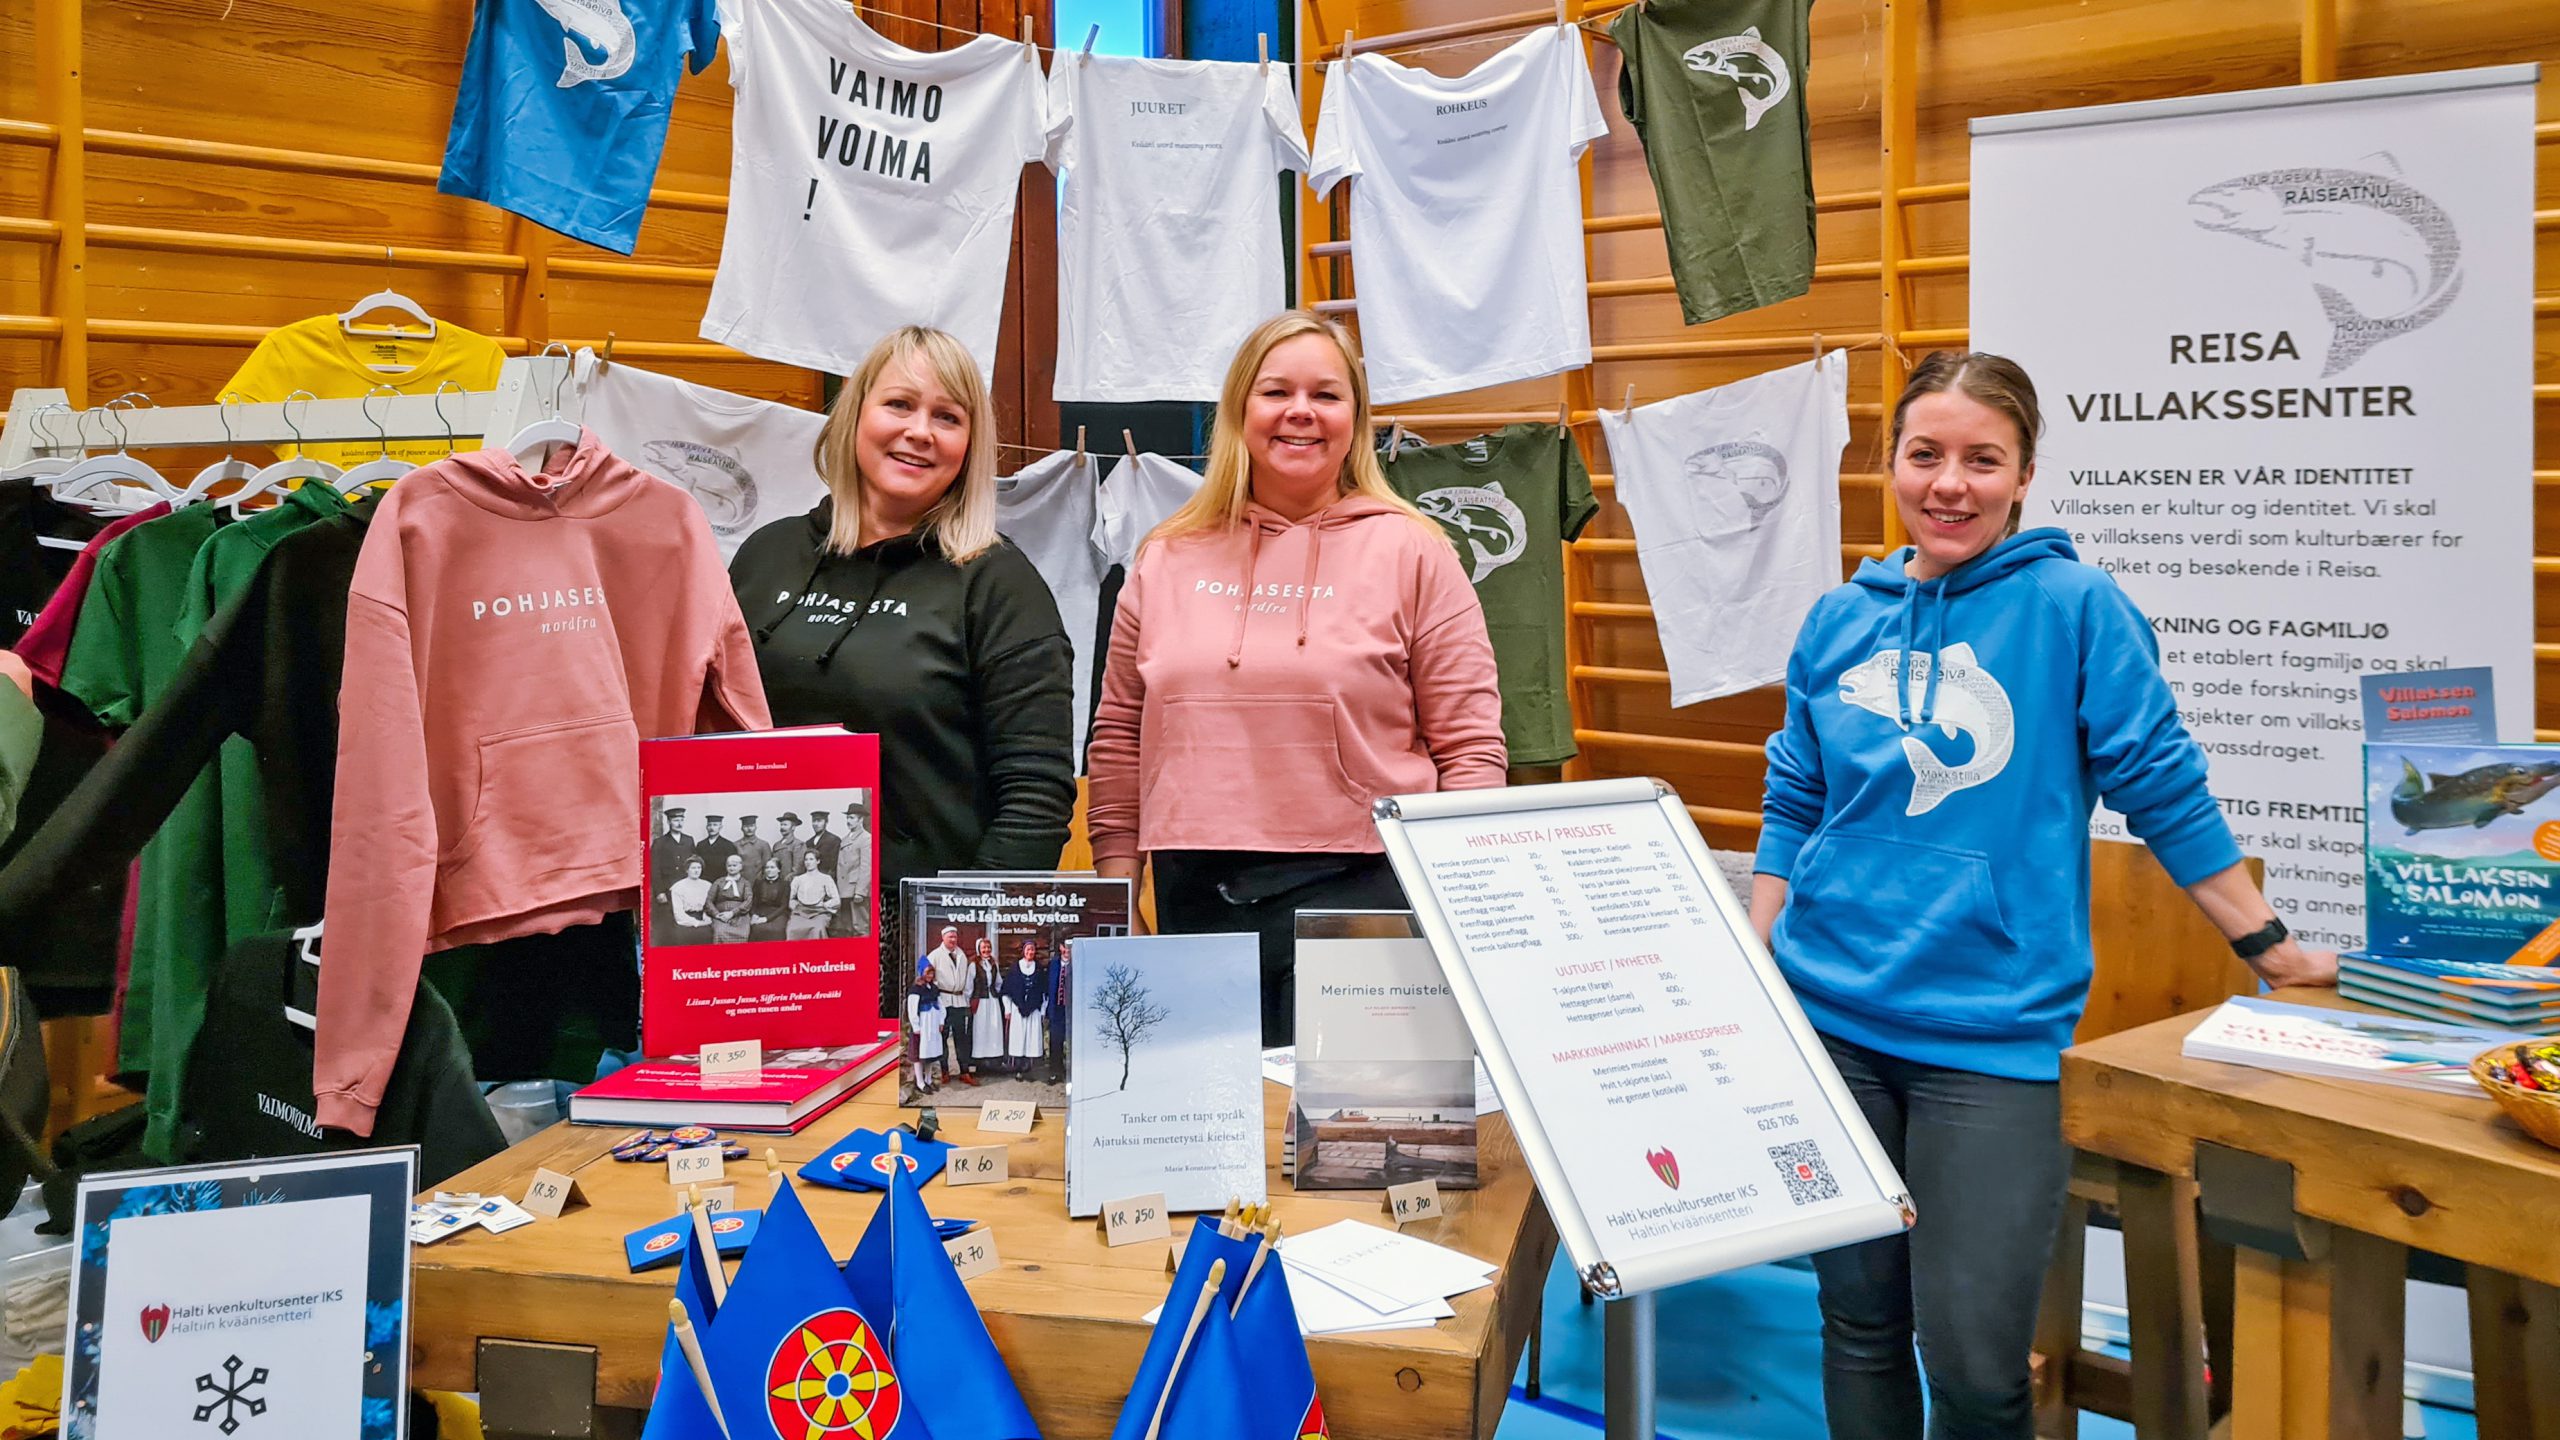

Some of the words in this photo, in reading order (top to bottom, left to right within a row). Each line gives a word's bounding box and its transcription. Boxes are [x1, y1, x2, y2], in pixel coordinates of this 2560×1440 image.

[830, 56, 943, 123] VAIMO
[1130, 101, 1186, 117] JUURET
[1436, 98, 1488, 116] ROHKEUS
[818, 115, 931, 183] VOIMA
[803, 178, 819, 221] !
[2170, 330, 2301, 365] REISA
[2067, 385, 2417, 423] VILLAKSSENTER
[2070, 470, 2192, 486] VILLAKSEN
[2199, 470, 2225, 486] ER
[2234, 465, 2286, 486] VÅR
[2295, 468, 2413, 485] IDENTITET
[2051, 499, 2135, 515] Villaksen
[2142, 504, 2161, 515] er
[2168, 499, 2224, 515] kultur
[2231, 504, 2256, 519] og
[2264, 498, 2355, 516] identitet.
[2364, 499, 2386, 515] Vi
[2393, 499, 2436, 516] skal
[2092, 529, 2184, 545] villaksens
[2191, 529, 2242, 546] verdi
[2249, 534, 2288, 546] som
[2295, 529, 2421, 548] kulturbærer
[2432, 530, 2464, 549] for
[2098, 557, 2151, 575] folket
[2158, 562, 2182, 578] og
[2189, 558, 2300, 577] besøkende
[2306, 561, 2312, 577] i
[2318, 560, 2382, 579] Reisa.
[1195, 579, 1334, 599] POHASESTA
[776, 590, 908, 617] PHJASSTA
[1234, 600, 1288, 614] nrdfra
[541, 616, 597, 634] nordfra
[2228, 618, 2261, 636] OG
[2268, 619, 2389, 640] FAGMILJØ
[2167, 650, 2186, 664] et
[2193, 649, 2274, 667] etablert
[2281, 651, 2363, 673] fagmiljø
[2192, 679, 2243, 698] gode
[2379, 686, 2476, 703] Villaksen
[2260, 714, 2290, 728] om
[2387, 705, 2472, 721] Salomon
[1466, 831, 1546, 849] HINTALISTA
[1554, 823, 1616, 841] PRISLISTE
[2261, 832, 2300, 851] skal
[941, 894, 1033, 907] Kvenfolkets
[1036, 894, 1067, 907] 500
[1069, 892, 1086, 907] år
[2273, 896, 2298, 913] og
[948, 910, 977, 923] ved
[978, 910, 1080, 926] Ishavskysten
[672, 968, 721, 981] Kvenske
[723, 965, 790, 982] personnavn
[799, 961, 856, 975] Nordreisa
[1556, 960, 1607, 977] UUTUUET
[1614, 953, 1663, 970] NYHETER
[1321, 984, 1385, 996] Merimies
[1552, 984, 1587, 997] T-skjorte
[1587, 980, 1613, 993] (farge)
[725, 1007, 736, 1017] og
[737, 1006, 756, 1014] noen
[757, 1005, 779, 1013] tusen
[781, 1003, 802, 1012] andre
[1559, 995, 1607, 1010] Hettegenser
[1608, 991, 1635, 1004] (dame)
[1566, 1008, 1614, 1024] Hettegenser
[1614, 1003, 1645, 1018] (unisex)
[1552, 1036, 1651, 1064] MARKKINAHINNAT
[1659, 1023, 1743, 1047] MARKEDSPRISER
[706, 1052, 719, 1064] KR
[728, 1050, 746, 1061] 350
[1592, 1063, 1630, 1077] Merimies
[1630, 1056, 1669, 1070] muistelee
[1600, 1079, 1617, 1091] Hvit
[1617, 1074, 1650, 1089] t-skjorte
[1650, 1071, 1672, 1084] (ass.)
[1607, 1093, 1624, 1105] Hvit
[1625, 1089, 1651, 1103] genser
[257, 1092, 323, 1140] VAIMOVOIMA
[986, 1109, 1000, 1121] KR
[1003, 1108, 1026, 1122] 250
[1743, 1099, 1795, 1115] Vippsnummer
[1121, 1113, 1156, 1124] Tanker
[1160, 1114, 1177, 1122] om
[1180, 1113, 1189, 1122] et
[1193, 1112, 1213, 1125] tapt
[1216, 1109, 1245, 1123] språk
[1757, 1117, 1779, 1131] 626
[1780, 1113, 1799, 1127] 706
[1093, 1136, 1140, 1149] Ajatuksii
[1143, 1132, 1204, 1146] menetetystä
[1207, 1129, 1245, 1142] kielestä
[676, 1158, 691, 1171] KR
[696, 1156, 710, 1169] 30
[953, 1158, 970, 1173] KR
[977, 1156, 993, 1172] 60
[532, 1181, 546, 1197] KR
[546, 1185, 558, 1199] 50
[704, 1199, 722, 1212] 70
[1396, 1199, 1409, 1215] KR
[1415, 1196, 1431, 1210] 300
[1606, 1210, 1637, 1229] Halti
[1639, 1191, 1737, 1223] kvenkultursenter
[1736, 1184, 1760, 1200] IKS
[1111, 1213, 1127, 1228] KR
[1135, 1207, 1155, 1224] 250
[1628, 1225, 1671, 1242] Haltiin
[1672, 1205, 1755, 1232] kväänisentteri
[967, 1244, 984, 1260] 70
[172, 1302, 204, 1319] Halti
[207, 1292, 318, 1316] kvenkultursenter
[321, 1289, 343, 1304] IKS
[171, 1319, 215, 1334] Haltiin
[218, 1308, 312, 1331] kväänisentteri
